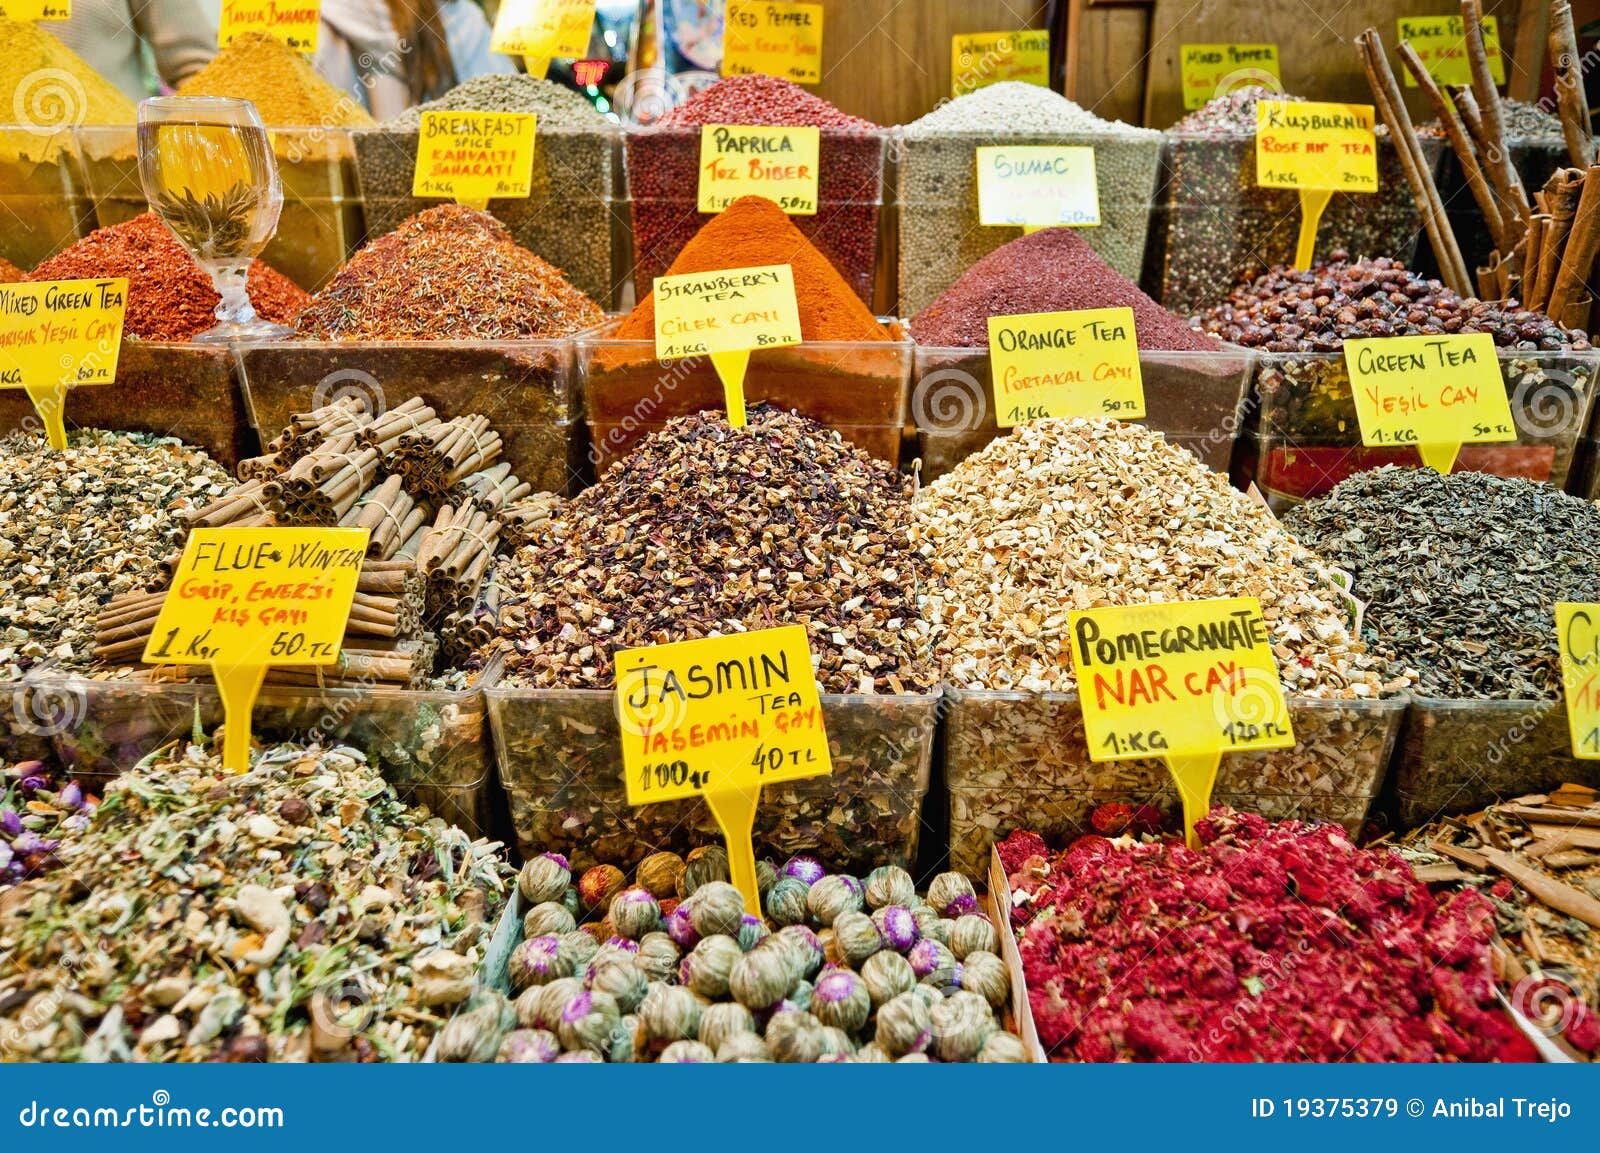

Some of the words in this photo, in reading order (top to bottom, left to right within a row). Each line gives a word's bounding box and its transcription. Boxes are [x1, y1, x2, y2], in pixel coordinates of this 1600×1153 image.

[728, 5, 759, 28] RED
[766, 5, 812, 27] PEPPER
[426, 114, 528, 138] BREAKFAST
[454, 137, 494, 149] SPICE
[713, 127, 794, 154] PAPRICA
[1261, 136, 1301, 154] ROSE
[1341, 143, 1374, 155] TEA
[431, 149, 517, 163] KAHVALTI
[994, 154, 1069, 178] SUMAC
[705, 157, 741, 182] TOZ
[45, 285, 93, 312] GREEN
[96, 281, 123, 310] TEA
[659, 271, 780, 301] STRAWBERRY
[700, 290, 745, 303] TEA
[998, 328, 1077, 352] ORANGE
[1083, 320, 1127, 342] TEA
[1358, 347, 1426, 375] GREEN
[1425, 340, 1477, 368] TEA
[1003, 365, 1088, 394] PORTAKAL
[1439, 385, 1479, 407] CAY
[287, 541, 364, 571] WINTER
[1075, 610, 1268, 666] POMEGRANATE
[1093, 663, 1178, 711] NAR
[747, 692, 803, 716] TEA
